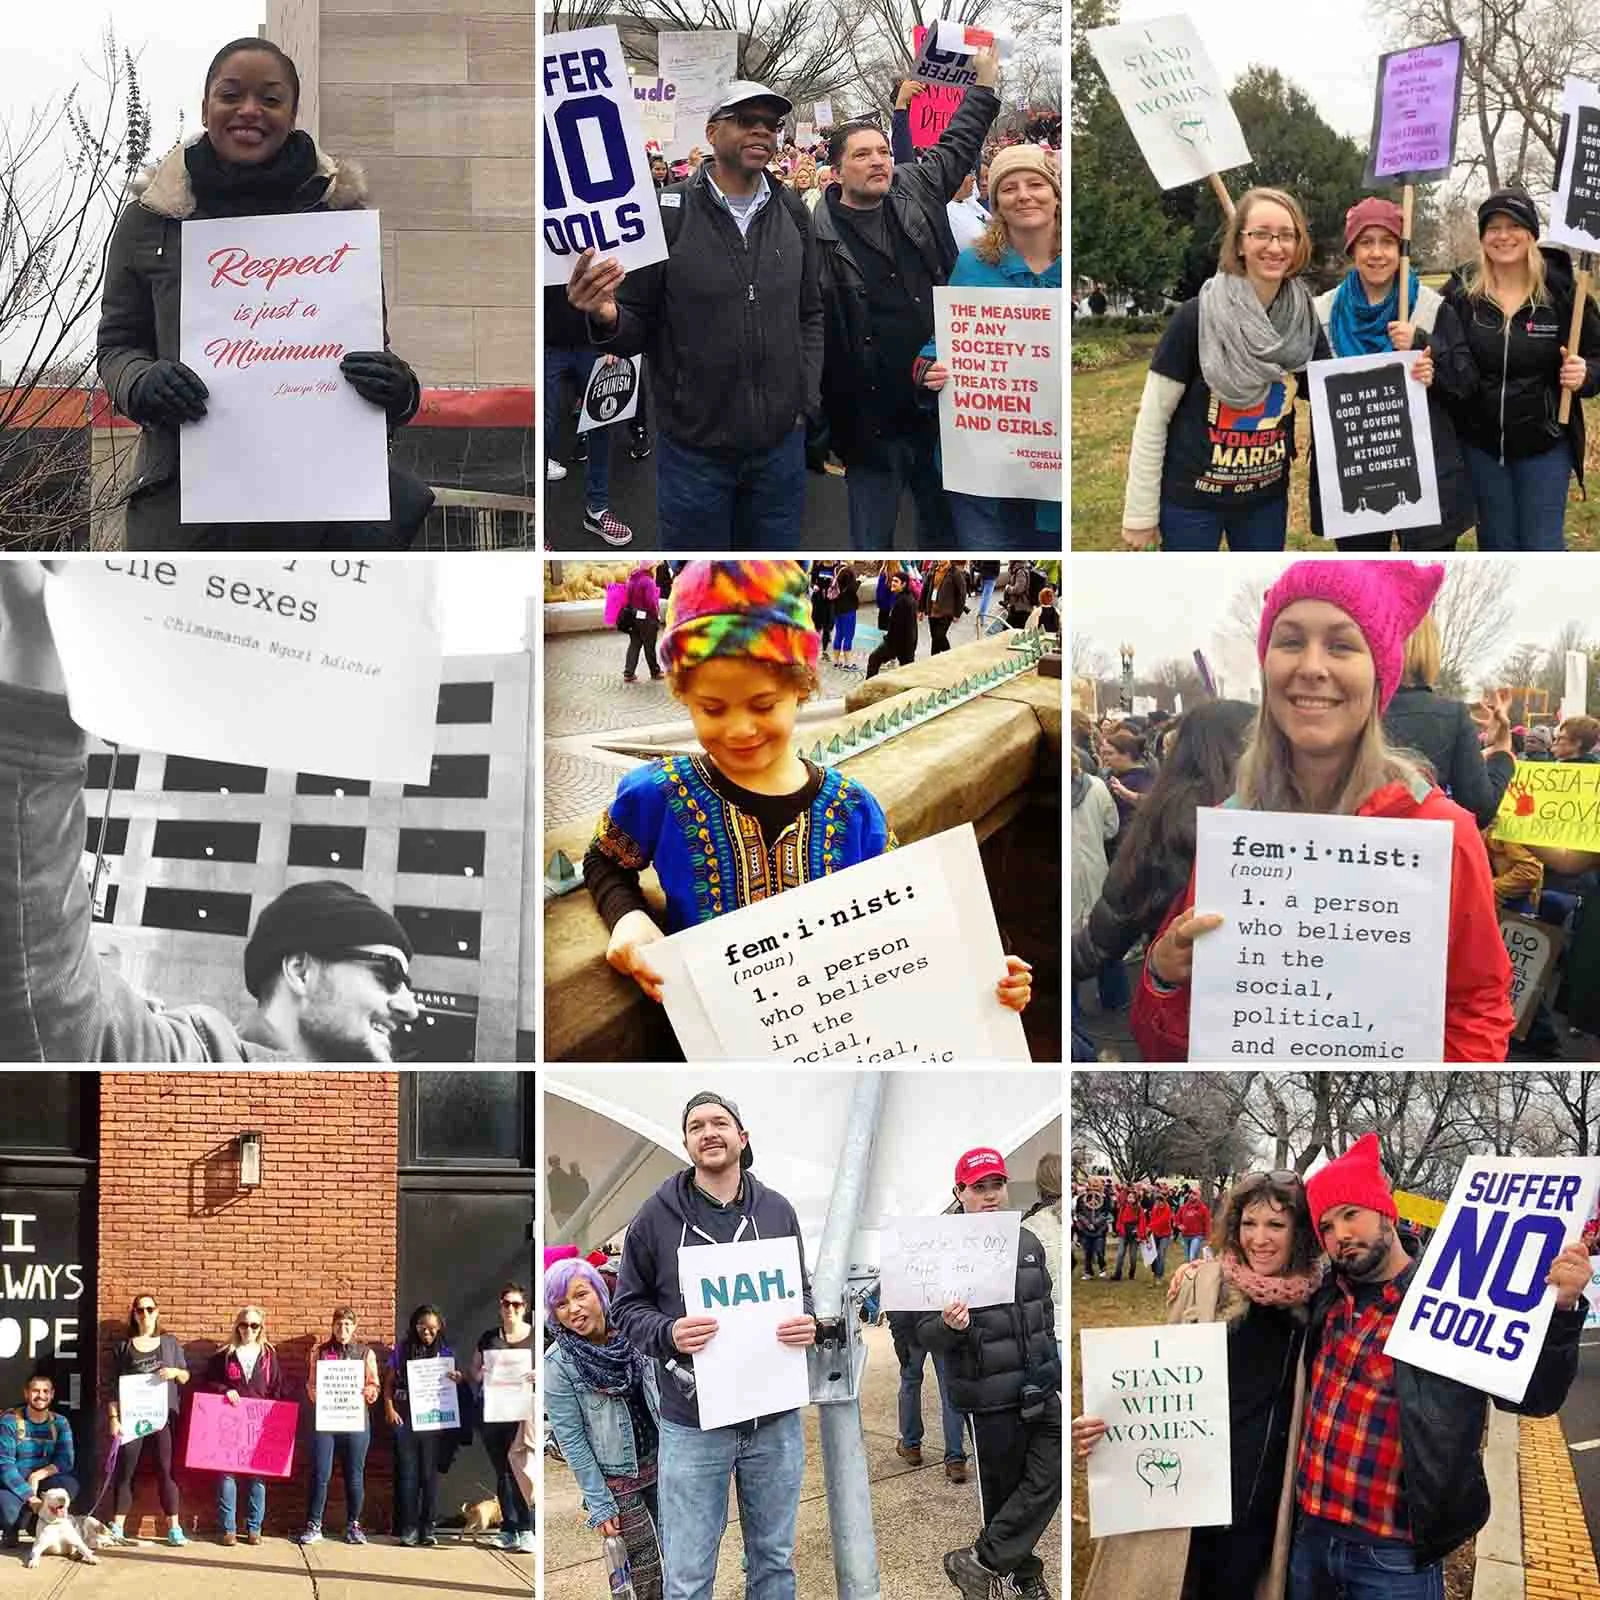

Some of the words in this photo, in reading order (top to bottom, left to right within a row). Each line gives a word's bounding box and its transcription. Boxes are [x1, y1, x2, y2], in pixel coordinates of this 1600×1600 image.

[1123, 47, 1192, 72] STAND
[633, 77, 677, 102] ude
[1139, 66, 1195, 90] WITH
[207, 240, 361, 292] Respect
[233, 303, 254, 321] is
[249, 298, 301, 329] just
[303, 303, 321, 318] a
[951, 303, 977, 317] THE
[981, 305, 1052, 321] MEASURE
[951, 321, 970, 334] OF
[975, 323, 1006, 336] ANY
[204, 337, 346, 370] Minimum
[952, 339, 1026, 357] SOCIETY
[1031, 345, 1051, 358] IS
[952, 357, 986, 372] HOW
[990, 360, 1009, 373] IT
[591, 375, 631, 400] FEMINISM
[953, 374, 1007, 391] TREATS
[1011, 379, 1039, 392] ITS
[1340, 393, 1353, 404] NO
[1359, 388, 1377, 401] MAN
[1383, 386, 1396, 396] IS
[954, 391, 1031, 414] WOMEN
[1336, 405, 1361, 419] GOOD
[1366, 399, 1404, 413] ENOUGH
[955, 414, 991, 431] AND
[997, 418, 1058, 437] GIRLS.
[1344, 422, 1357, 432] TO
[1362, 414, 1400, 429] GOVERN
[1346, 434, 1364, 447] ANY
[1370, 428, 1402, 442] WOMAN
[1211, 440, 1287, 468] MARCH
[1354, 443, 1397, 460] WITHOUT
[1343, 465, 1362, 477] HER
[1368, 456, 1412, 472] CONSENT
[1195, 479, 1223, 493] HEAR
[205, 574, 318, 623] sexes
[1230, 863, 1293, 880] (noun)
[1241, 888, 1266, 907] 1.
[1285, 894, 1298, 908] a
[1313, 895, 1400, 914] person
[1238, 918, 1283, 937] who
[1297, 921, 1412, 944] believes
[1511, 930, 1539, 951] DO
[733, 951, 795, 985] (noun)
[1237, 947, 1266, 966] in
[1281, 949, 1325, 969] the
[1506, 946, 1535, 967] OT
[752, 987, 779, 1003] 1.
[796, 974, 812, 988] a
[823, 936, 910, 981] person
[760, 1003, 805, 1028] who
[816, 955, 929, 1007] believes
[1235, 978, 1334, 1001] social,
[771, 1032, 800, 1052] in
[812, 1011, 855, 1034] the
[1232, 1007, 1376, 1033] political,
[1231, 1036, 1275, 1056] and
[1290, 1040, 1405, 1060] economic
[1465, 1171, 1583, 1212] SUFFER
[0, 1212, 37, 1253] I
[1426, 1205, 1567, 1314] NO
[0, 1263, 85, 1300] WAYS
[700, 1268, 796, 1309] NAH.
[1409, 1294, 1531, 1362] FOOLS
[1153, 1339, 1160, 1359] I
[1111, 1365, 1204, 1390] STAND
[1121, 1393, 1193, 1415] WITH
[1103, 1418, 1215, 1443] WOMEN.
